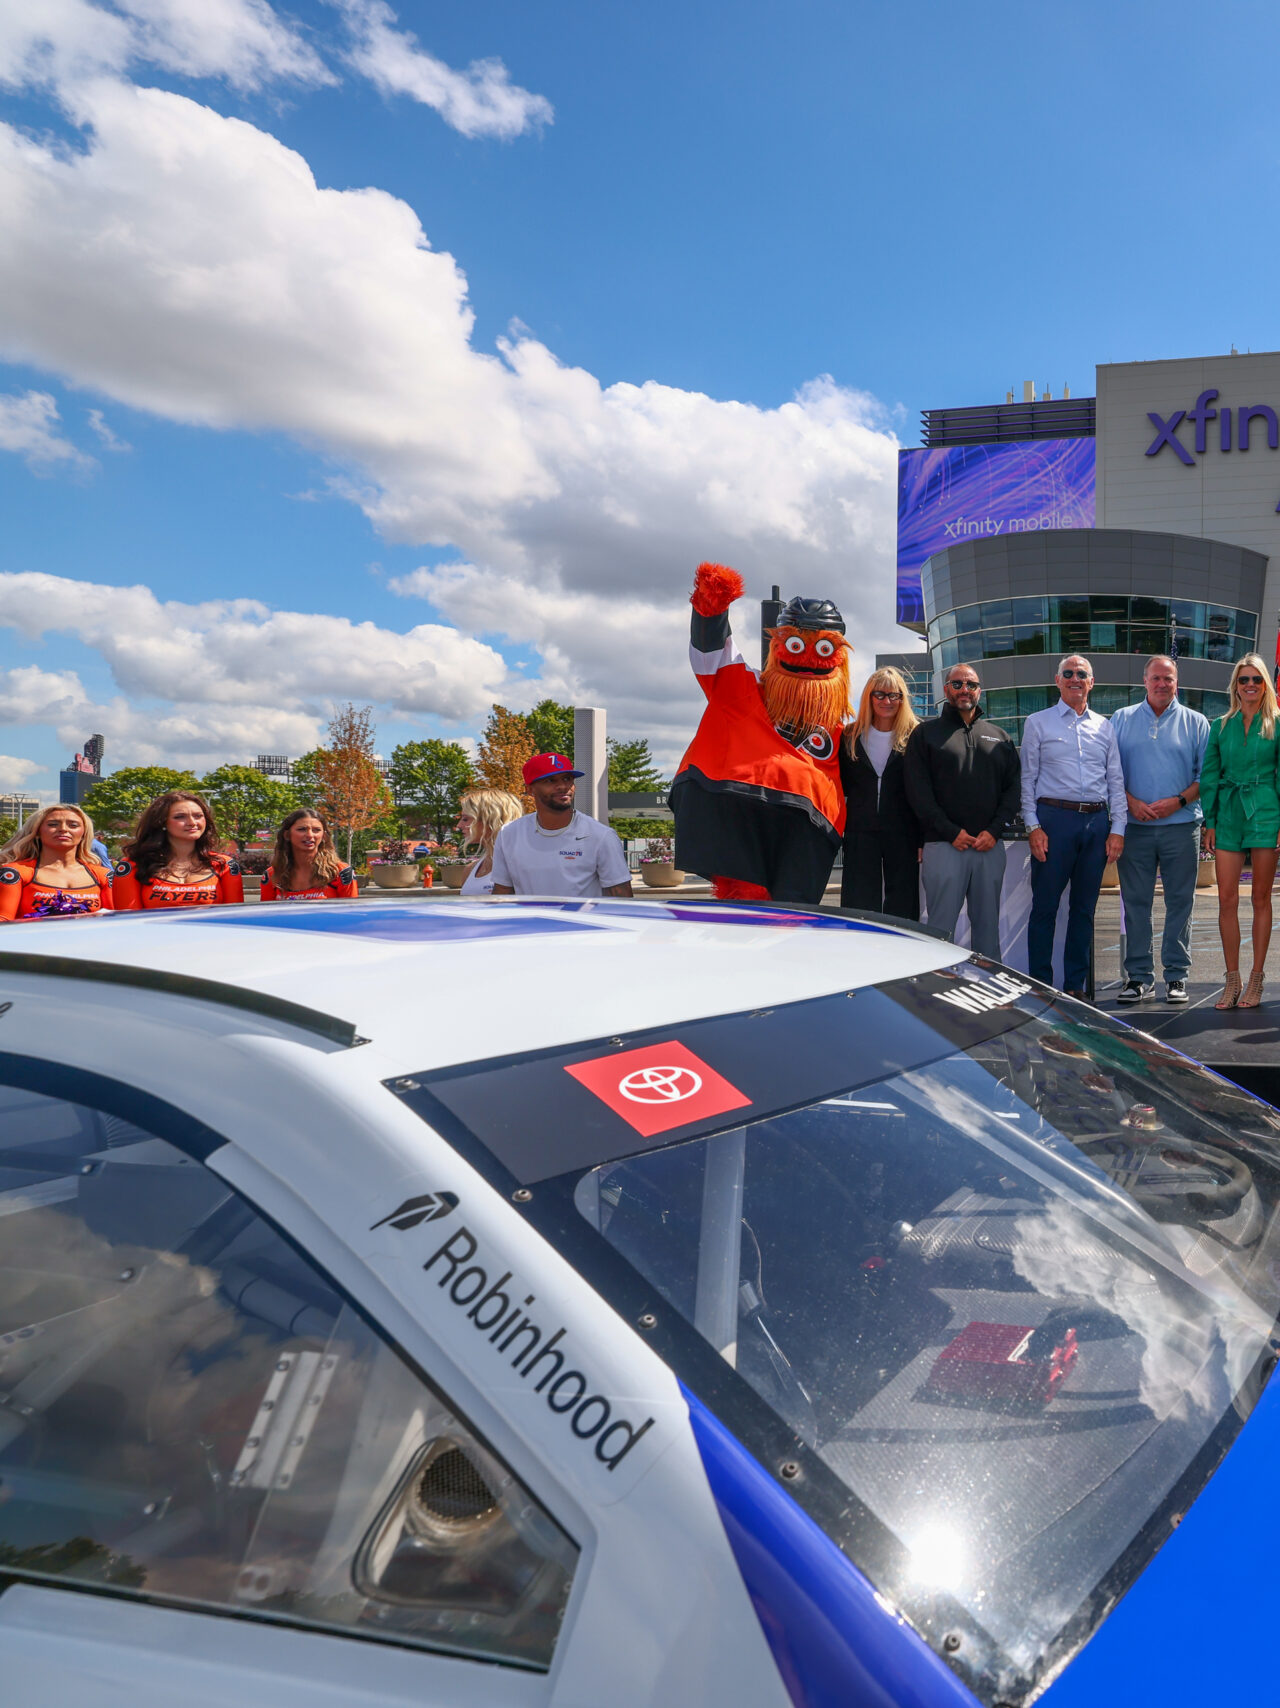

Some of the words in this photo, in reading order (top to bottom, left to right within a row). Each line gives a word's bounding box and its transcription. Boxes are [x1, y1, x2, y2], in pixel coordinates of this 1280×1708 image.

[943, 516, 1004, 538] xfinity
[1008, 512, 1073, 532] mobile
[548, 755, 564, 769] 76
[33, 891, 98, 899] PHILELPHIA
[150, 891, 217, 902] FLYERS
[423, 1226, 655, 1472] Robinhood
